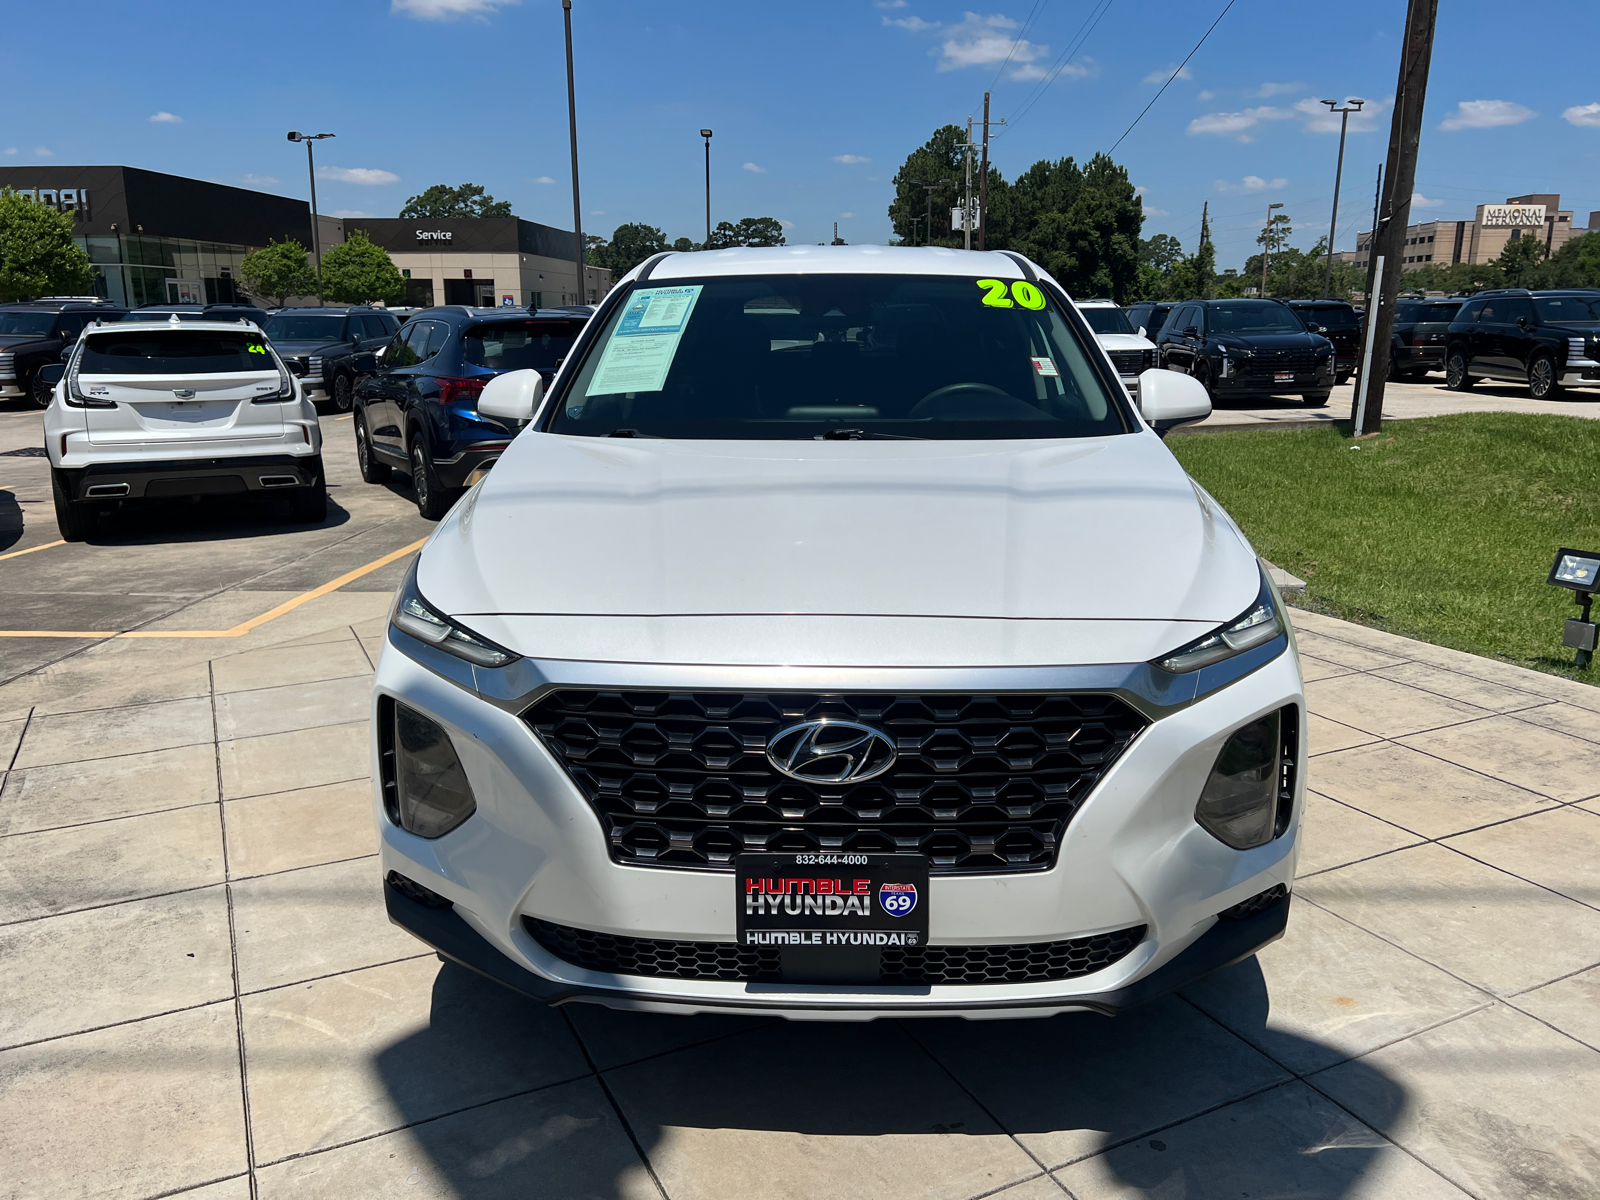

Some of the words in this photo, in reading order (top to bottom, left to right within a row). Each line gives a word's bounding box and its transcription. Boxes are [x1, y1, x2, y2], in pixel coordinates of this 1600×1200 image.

[1487, 208, 1542, 218] MEMORIAL
[1487, 216, 1541, 225] HERMANN
[416, 230, 452, 240] Service
[976, 279, 1046, 310] 20
[796, 855, 868, 864] 832-644-4000
[746, 878, 870, 895] HUMBLE
[746, 895, 870, 916] HYUNDAI
[885, 896, 911, 910] 69
[746, 932, 822, 945] HUMBLE
[826, 932, 905, 945] HYUNDAI
